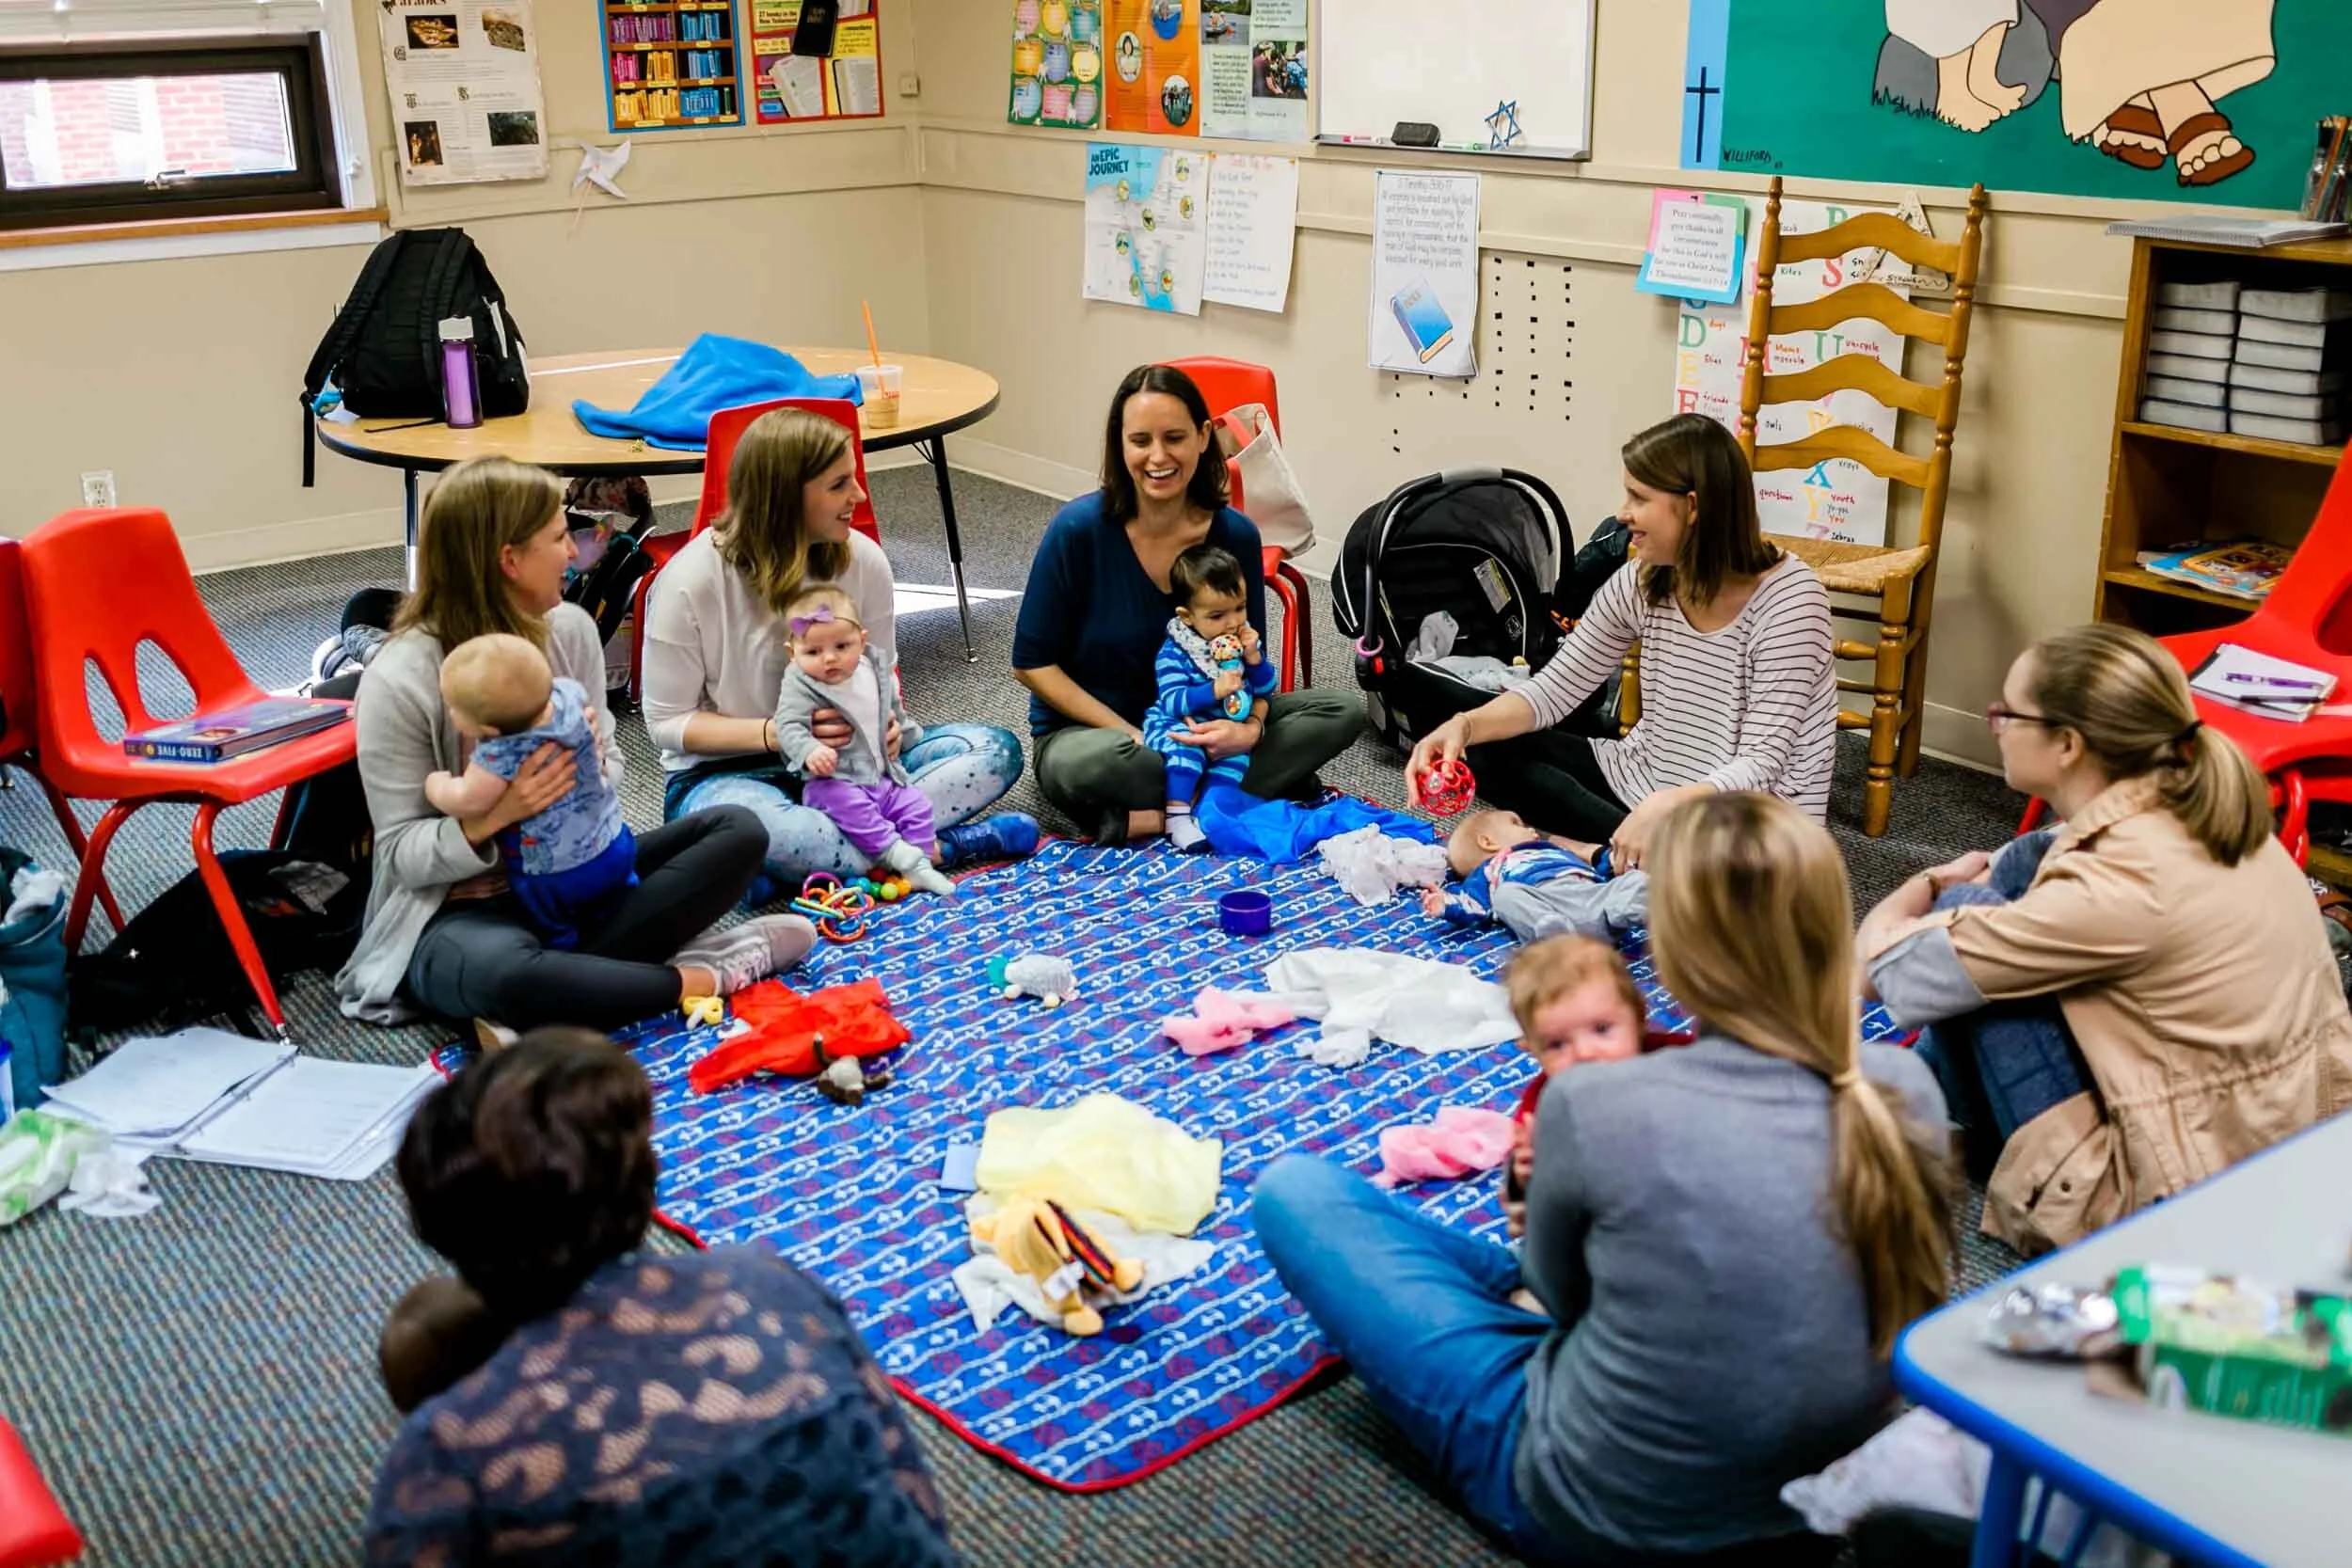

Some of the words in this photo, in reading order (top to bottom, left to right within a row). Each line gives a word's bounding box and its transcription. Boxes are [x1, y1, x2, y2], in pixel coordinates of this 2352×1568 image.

[1089, 160, 1129, 176] JOURNEY
[1822, 257, 1843, 287] S
[1678, 313, 1707, 348] D
[1814, 332, 1845, 363] U
[1679, 352, 1702, 386] E
[1804, 460, 1833, 489] X
[1800, 484, 1830, 522] Y
